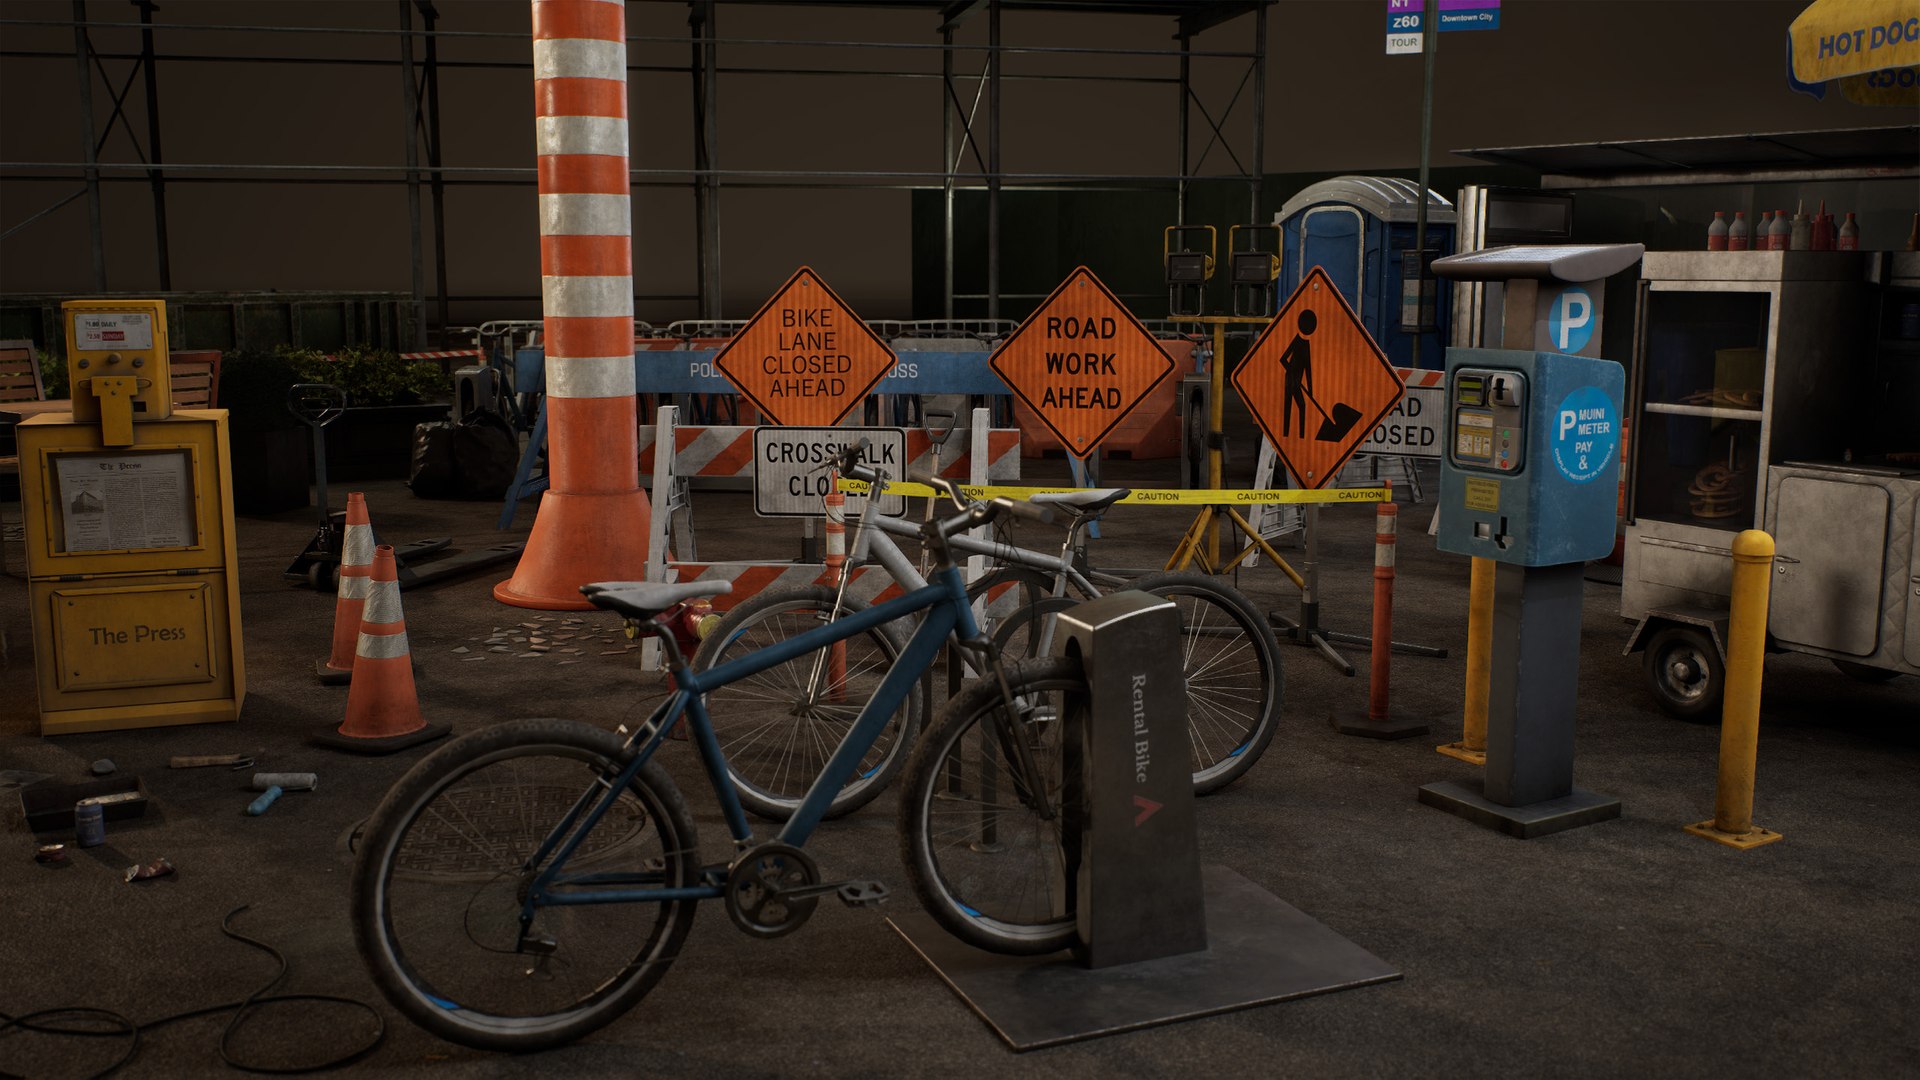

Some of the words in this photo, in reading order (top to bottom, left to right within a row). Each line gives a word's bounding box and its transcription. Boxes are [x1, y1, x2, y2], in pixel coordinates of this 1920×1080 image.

[1442, 14, 1478, 22] Downtown
[1479, 13, 1493, 22] City
[1391, 38, 1417, 47] TOUR
[1818, 29, 1865, 60] HOT
[782, 309, 833, 327] BIKE
[1559, 292, 1591, 349] P
[1047, 317, 1116, 339] ROAD
[779, 332, 836, 351] LANE
[763, 355, 852, 375] CLOSED
[1045, 352, 1117, 375] WORK
[770, 379, 846, 398] AHEAD
[1041, 387, 1121, 409] AHEAD
[1578, 408, 1605, 420] MUINI
[1559, 410, 1577, 441] P
[1578, 422, 1610, 436] METER
[1575, 441, 1593, 454] PAY
[1578, 454, 1588, 470] &
[1137, 492, 1179, 501] CAUTION
[1236, 492, 1280, 501] CAUTION
[1338, 491, 1382, 499] CAUTION
[89, 627, 128, 645] The
[135, 625, 186, 643] Press
[1132, 673, 1149, 736] Rental
[1135, 740, 1150, 784] Bike
